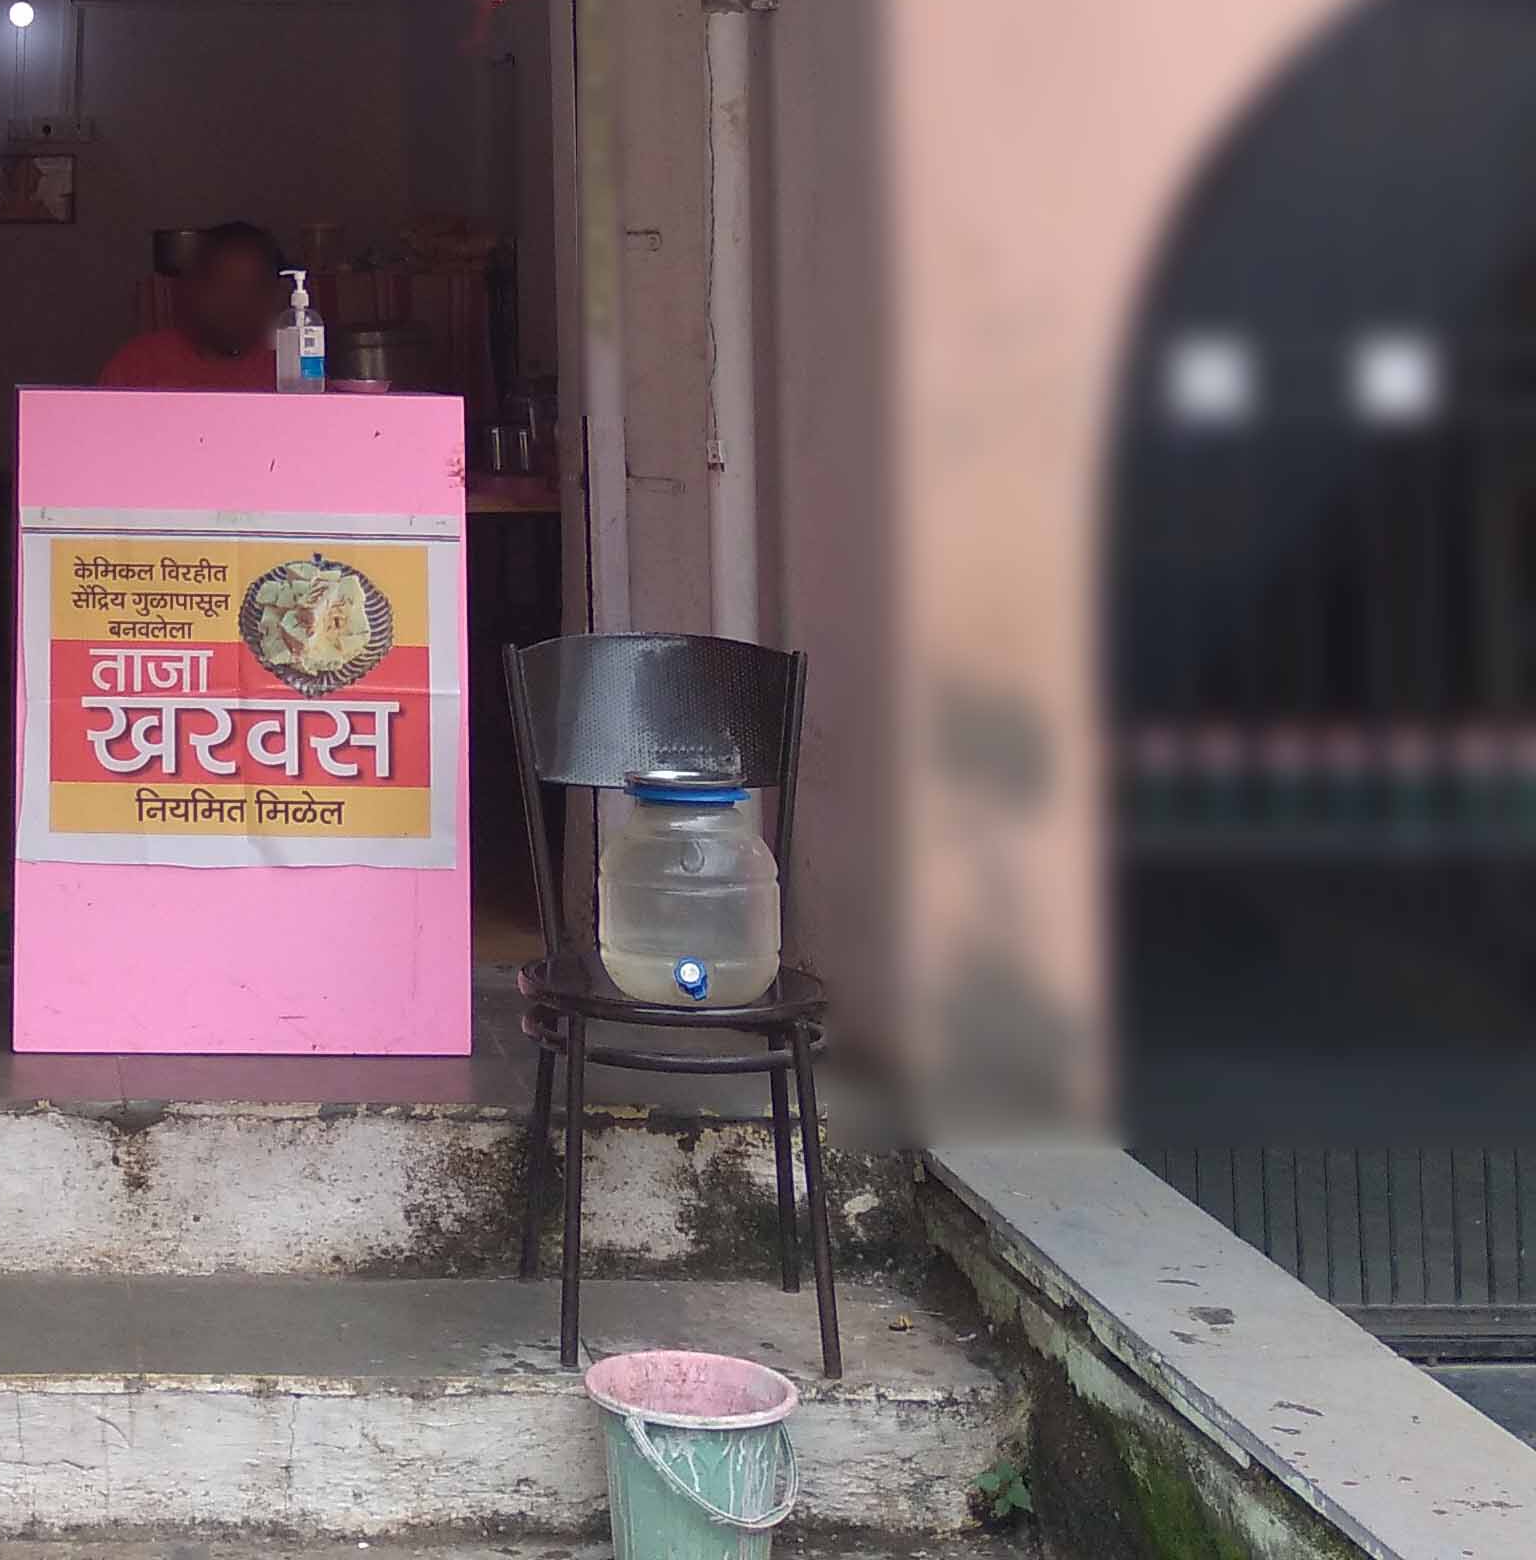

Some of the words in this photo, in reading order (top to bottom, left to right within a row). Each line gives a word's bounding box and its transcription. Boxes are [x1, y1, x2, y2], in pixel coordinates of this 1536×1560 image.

[73, 556, 154, 581] केमिकल
[160, 557, 228, 583] विरहीत
[72, 584, 127, 611] सेंद्रिय
[131, 592, 231, 618] गुळापासून
[108, 615, 193, 639] बनवलेला
[89, 648, 213, 693] ताजा
[81, 696, 400, 778] खरवस
[135, 788, 247, 824] नियमित
[255, 790, 345, 825] मिळेल
